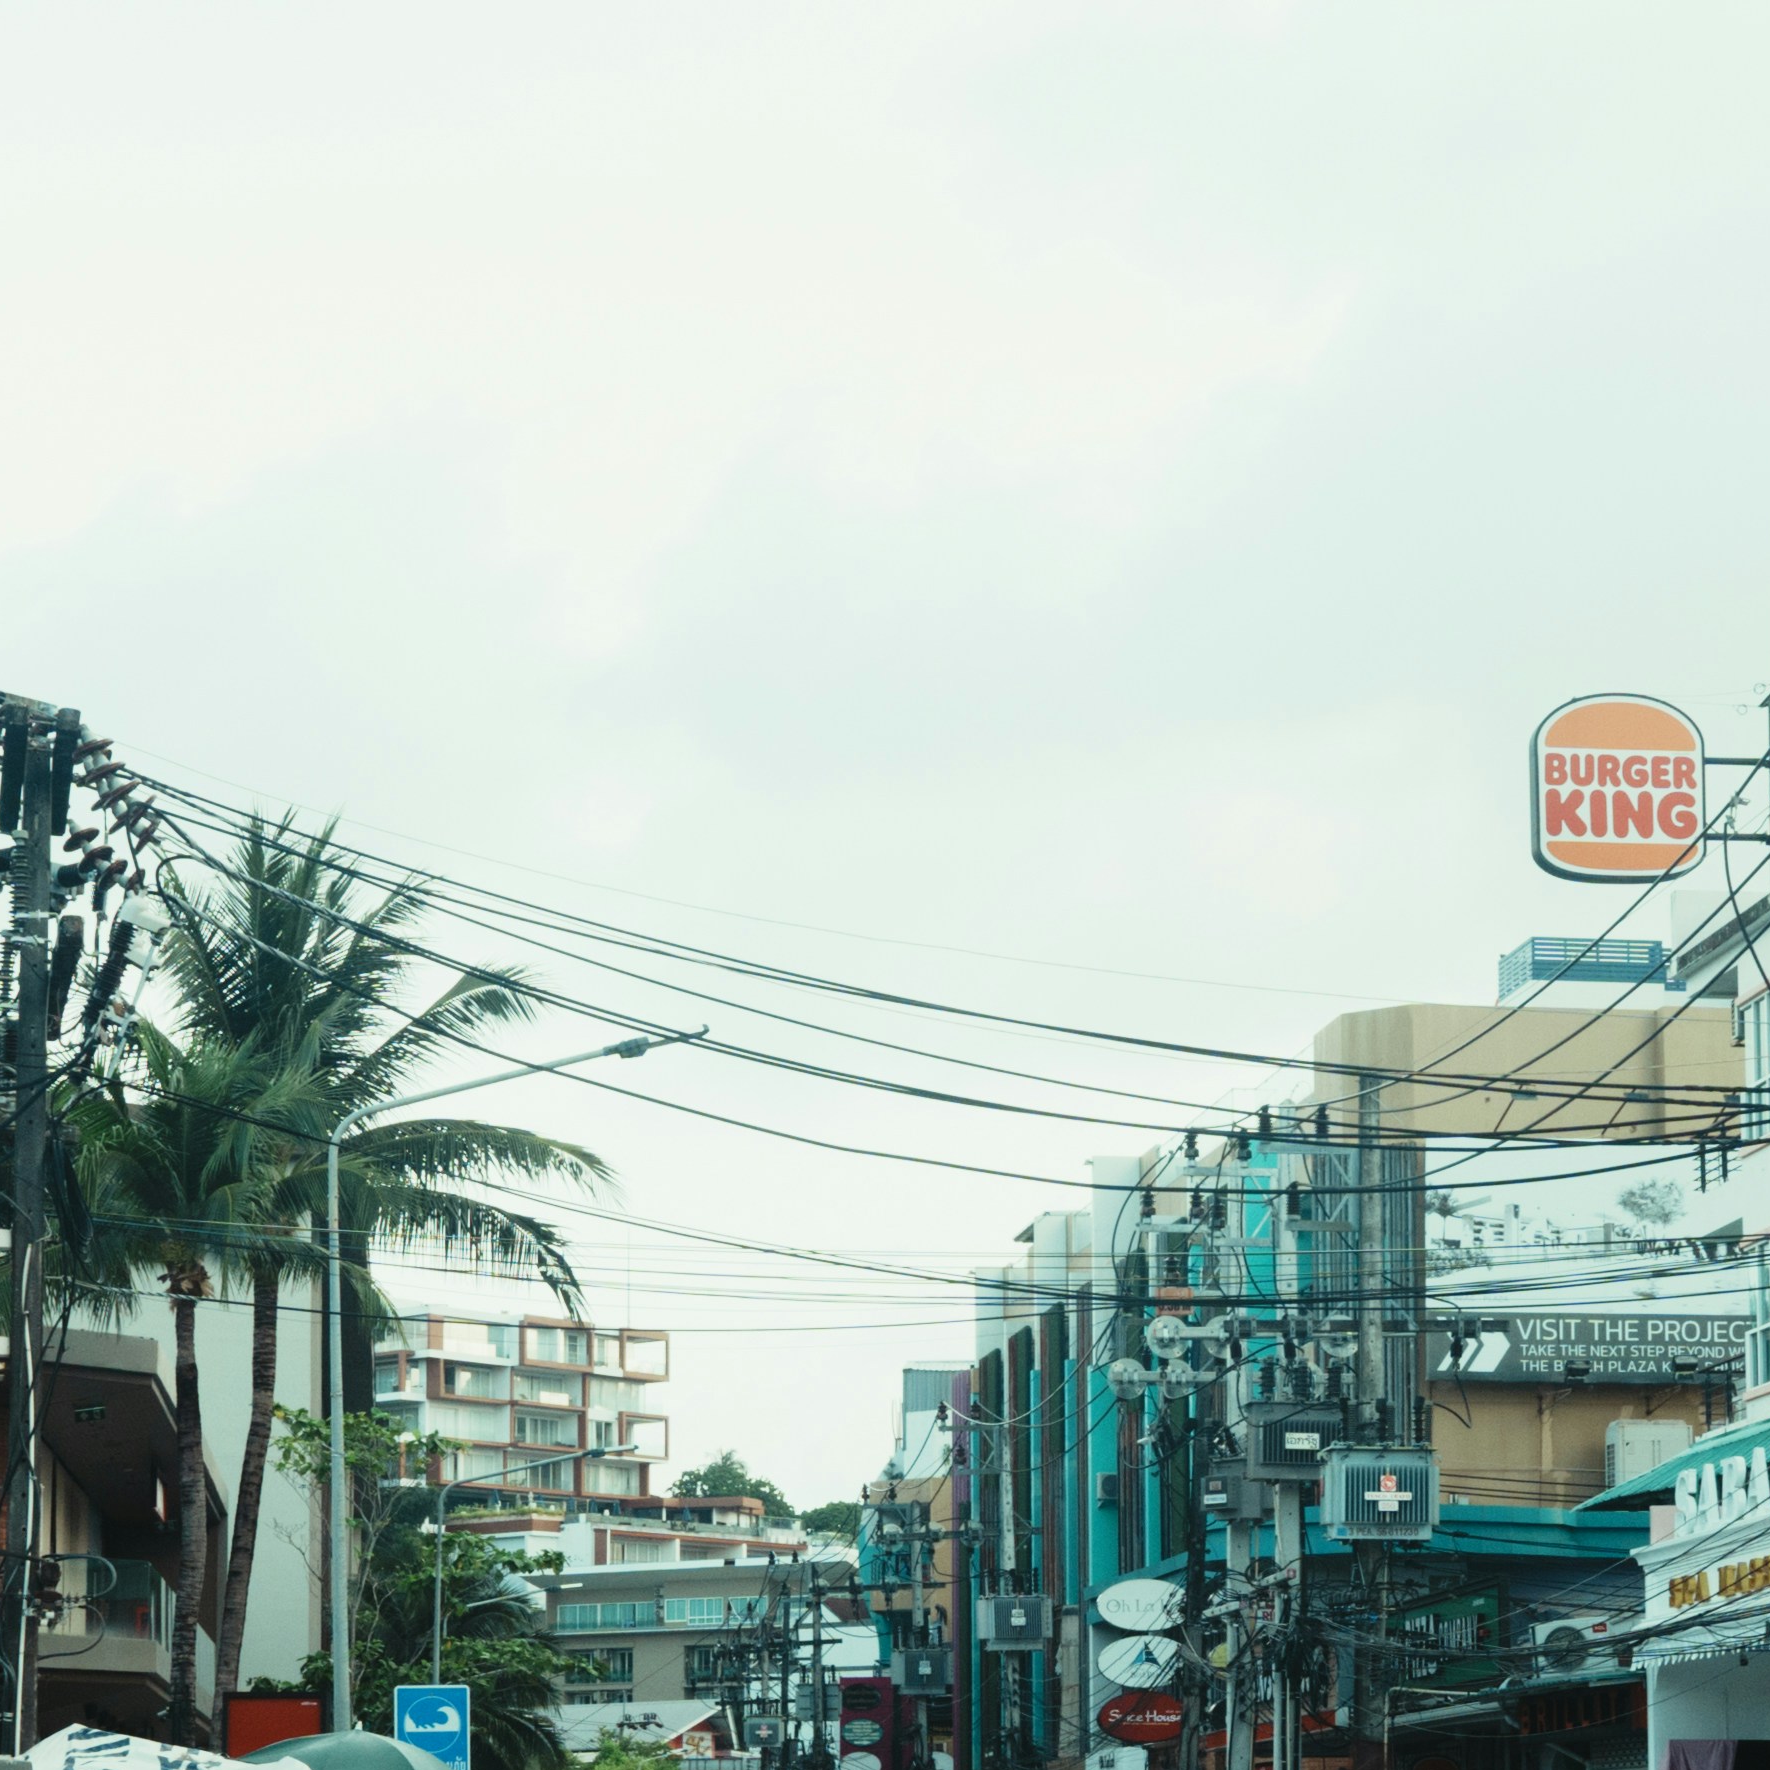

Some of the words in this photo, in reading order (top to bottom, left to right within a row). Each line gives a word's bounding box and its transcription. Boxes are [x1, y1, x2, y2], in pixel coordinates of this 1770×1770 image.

[1544, 753, 1698, 790] BURGER
[1545, 788, 1699, 840] KING
[1516, 1318, 1581, 1341] VISIT
[1588, 1319, 1639, 1342] THE
[1520, 1344, 1556, 1357] TAKE
[1559, 1344, 1586, 1357] THE
[1590, 1345, 1627, 1358] NEXT
[1631, 1345, 1665, 1358] STEP
[1668, 1346, 1726, 1359] BEYOND
[1520, 1360, 1549, 1372] THE
[1608, 1361, 1657, 1373] PLAZA
[1669, 1571, 1711, 1609] SPA
[1106, 1598, 1130, 1614] Oh
[1136, 1598, 1155, 1614] La
[1108, 1709, 1144, 1723] Sice
